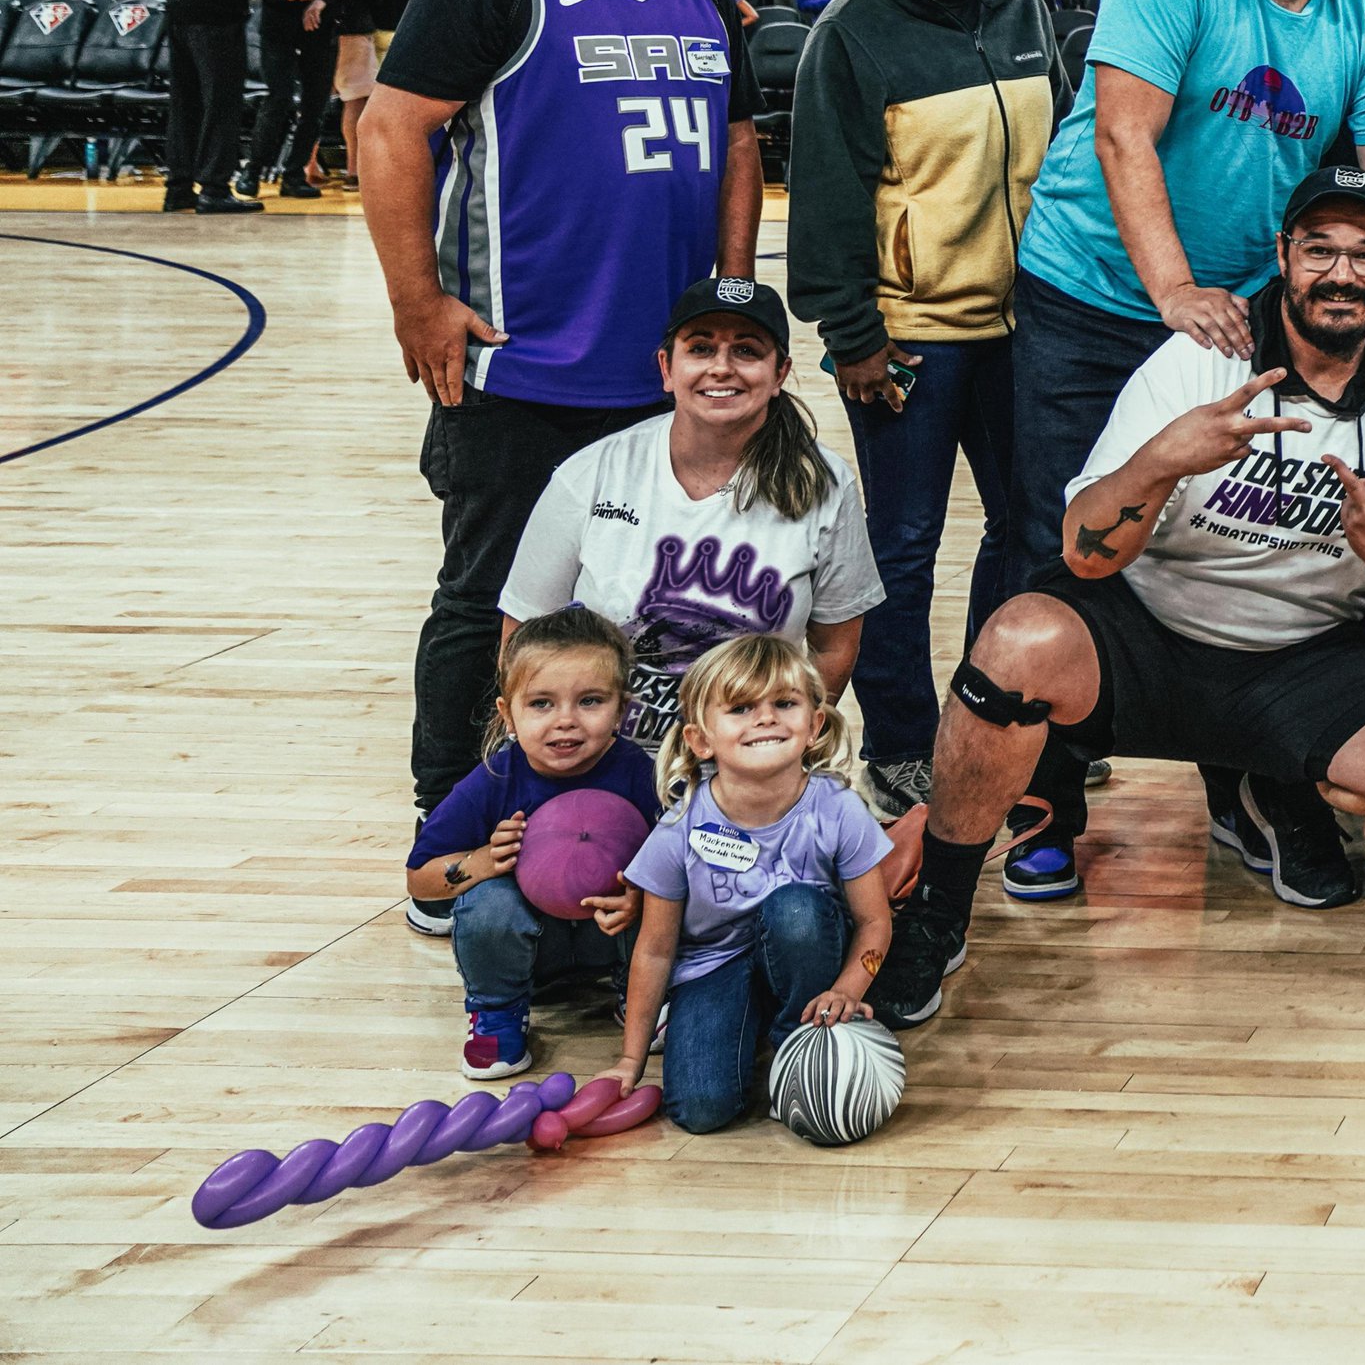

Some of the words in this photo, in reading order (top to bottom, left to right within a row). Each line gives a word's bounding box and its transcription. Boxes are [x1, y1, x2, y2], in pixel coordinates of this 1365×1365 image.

[573, 34, 724, 84] SAC
[616, 96, 711, 173] 24
[1208, 87, 1255, 122] OTB
[1274, 111, 1320, 140] B2B
[719, 825, 741, 837] Hello
